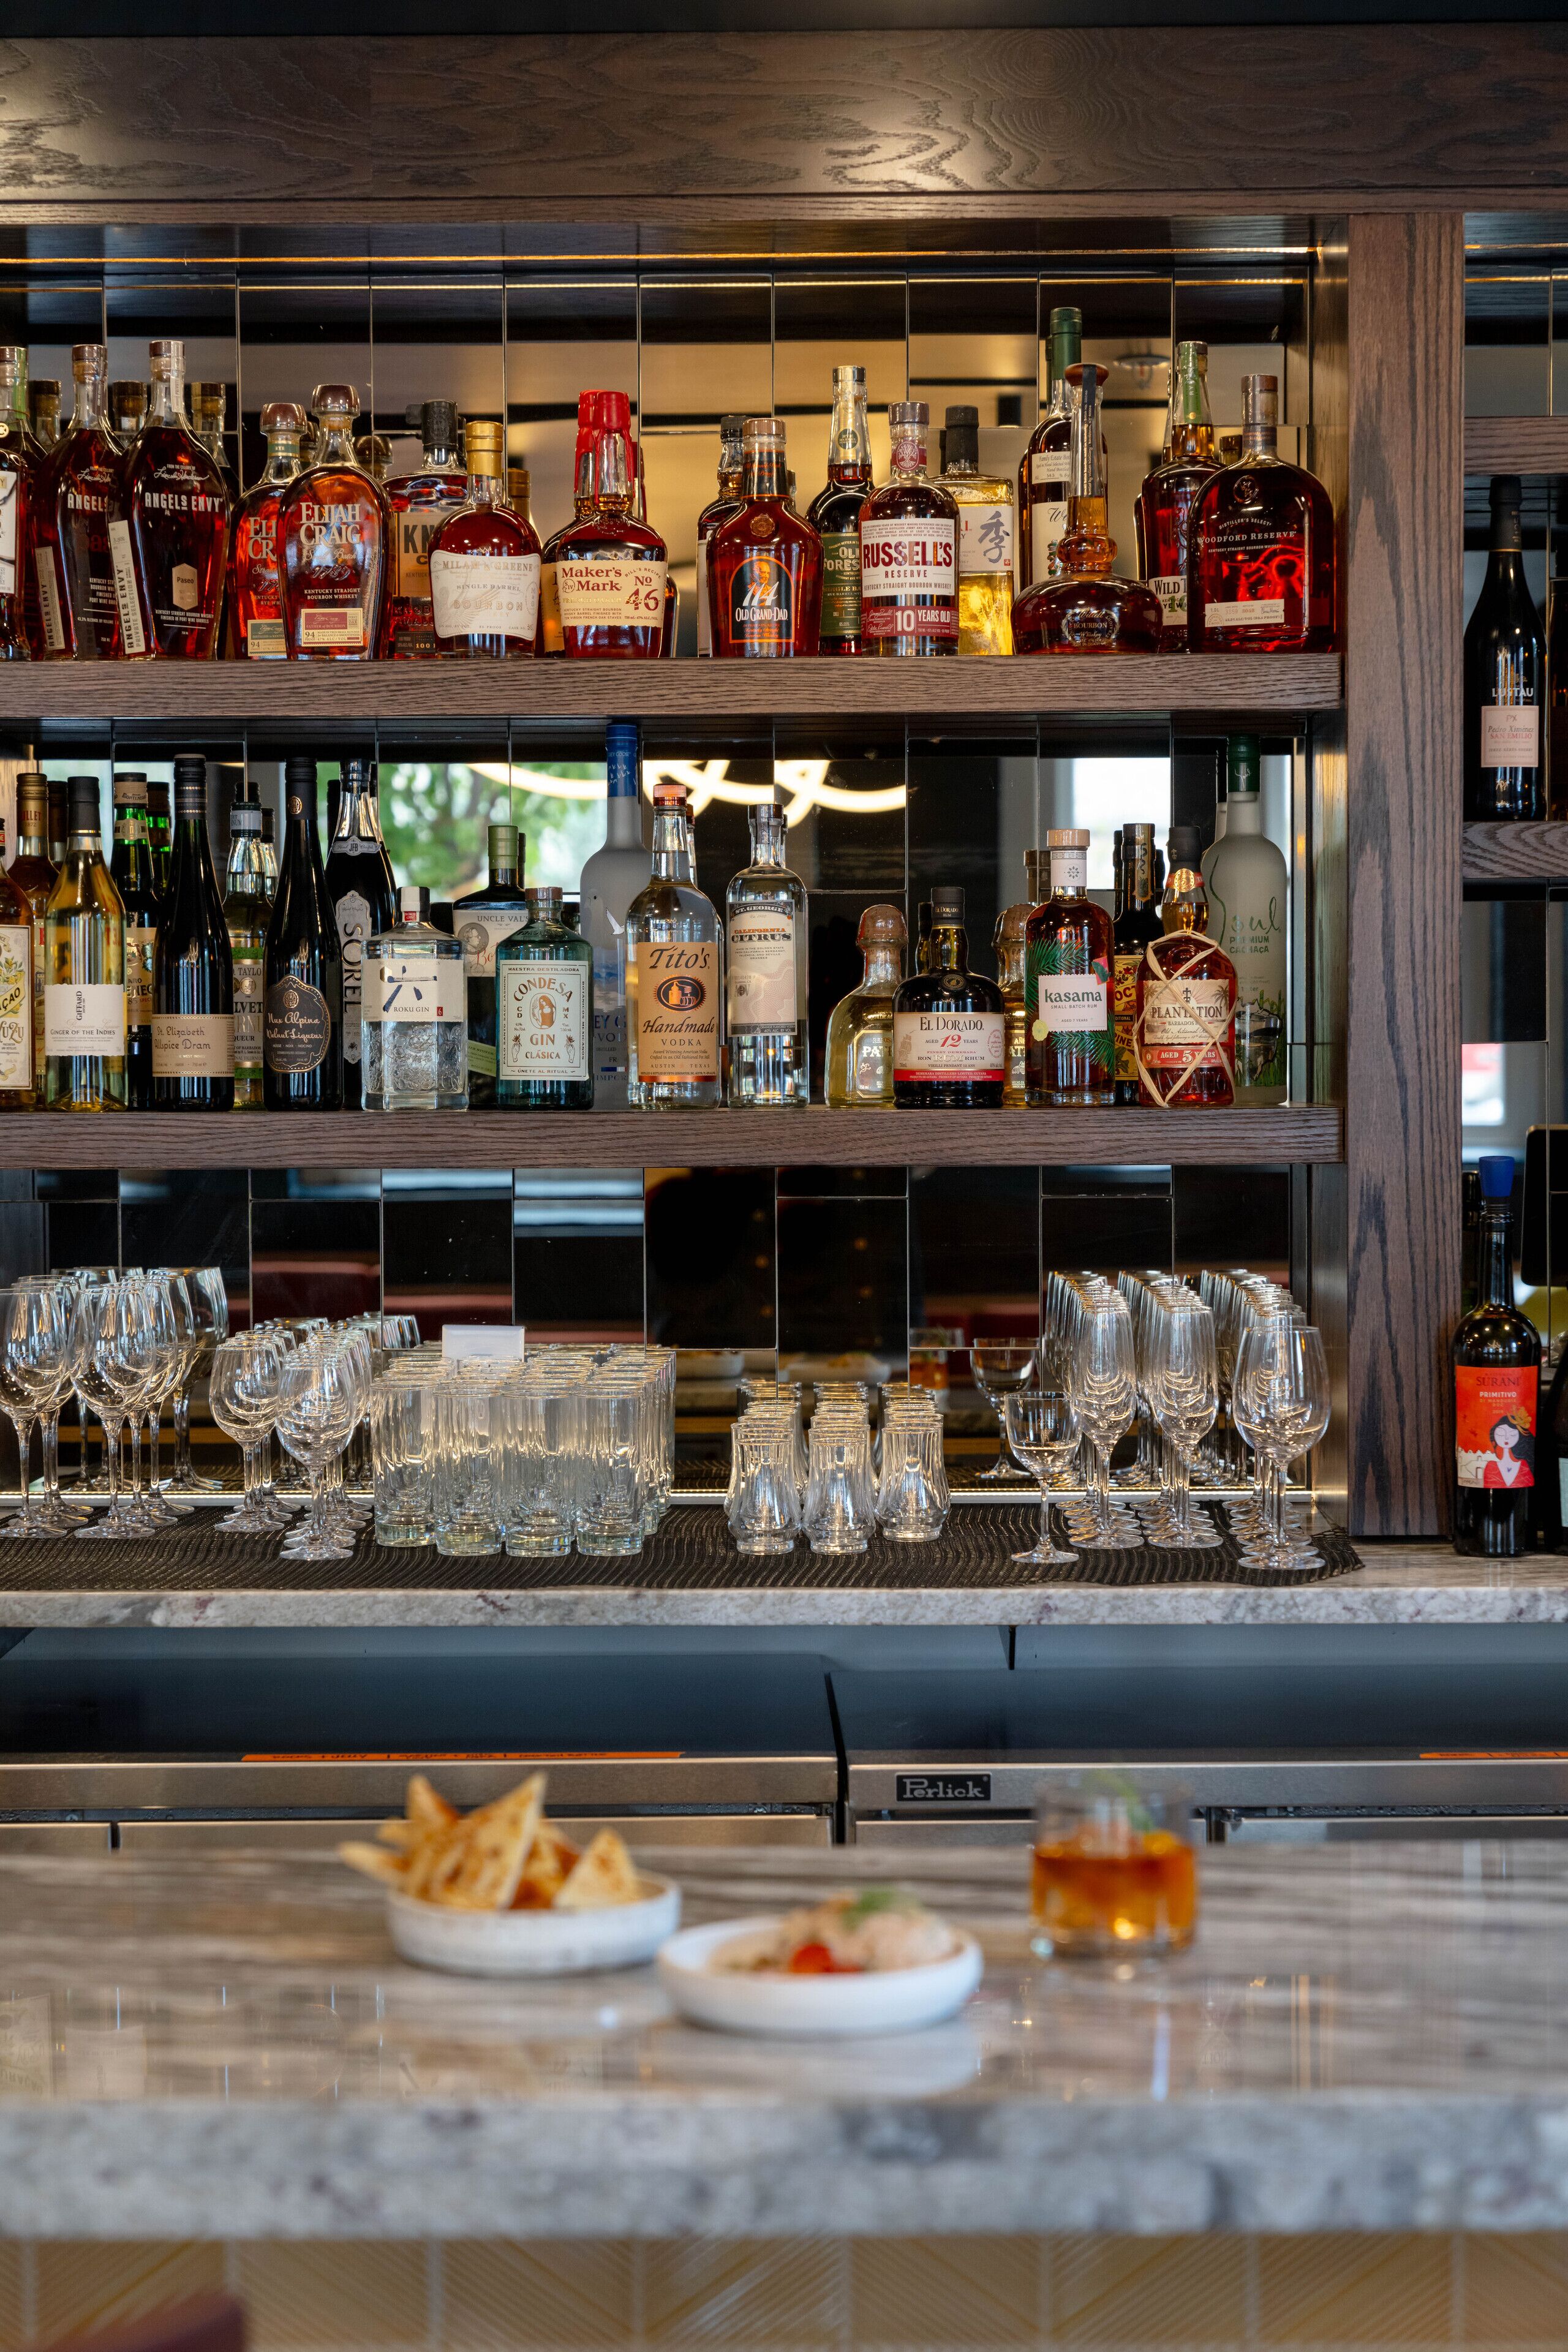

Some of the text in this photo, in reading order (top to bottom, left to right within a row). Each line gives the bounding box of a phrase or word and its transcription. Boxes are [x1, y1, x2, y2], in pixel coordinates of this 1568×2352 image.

[145, 492, 221, 513] ANGELS ENVY
[300, 502, 361, 526] ELIJAH
[300, 523, 361, 547] CRAIG
[1197, 531, 1295, 544] WOODFORD RESERVE
[863, 541, 953, 569] RUSSELL'S
[442, 560, 533, 572] MILAM GREENE
[562, 567, 622, 578] Maker's
[625, 567, 642, 578] BILL'S
[885, 570, 927, 578] RESERVE
[576, 580, 622, 592] Mark
[1154, 579, 1180, 595] WILD
[625, 588, 659, 611] 46
[742, 581, 780, 606] 114
[116, 567, 135, 649] ANGELS ENVY
[454, 600, 523, 611] BOURBON
[735, 606, 788, 622] OLD GRAND-DAD
[895, 609, 915, 632] 10
[918, 609, 950, 623] YEARS OLD
[349, 843, 358, 852] JFB
[731, 933, 792, 944] CITRUS
[649, 945, 710, 970] Tito's
[343, 922, 363, 1014] SOREL
[513, 977, 574, 1003] CONDESA
[1045, 989, 1102, 1003] kasama
[1152, 1005, 1223, 1019] PLANTTION
[268, 1012, 284, 1024] Nux
[284, 1011, 321, 1028] Alpina
[642, 1016, 715, 1034] Handmade
[919, 1017, 933, 1031] EL
[166, 1025, 205, 1038] Elizabeth
[266, 1028, 323, 1043] Walnut Liqueur
[181, 1038, 211, 1050] Dram
[530, 1033, 556, 1046] GIN
[940, 1034, 962, 1048] 12
[525, 1049, 561, 1060] CLÁSICA
[1182, 1050, 1194, 1064] 5
[1476, 1376, 1521, 1387] SURANI
[902, 1778, 984, 1798] Perlick
